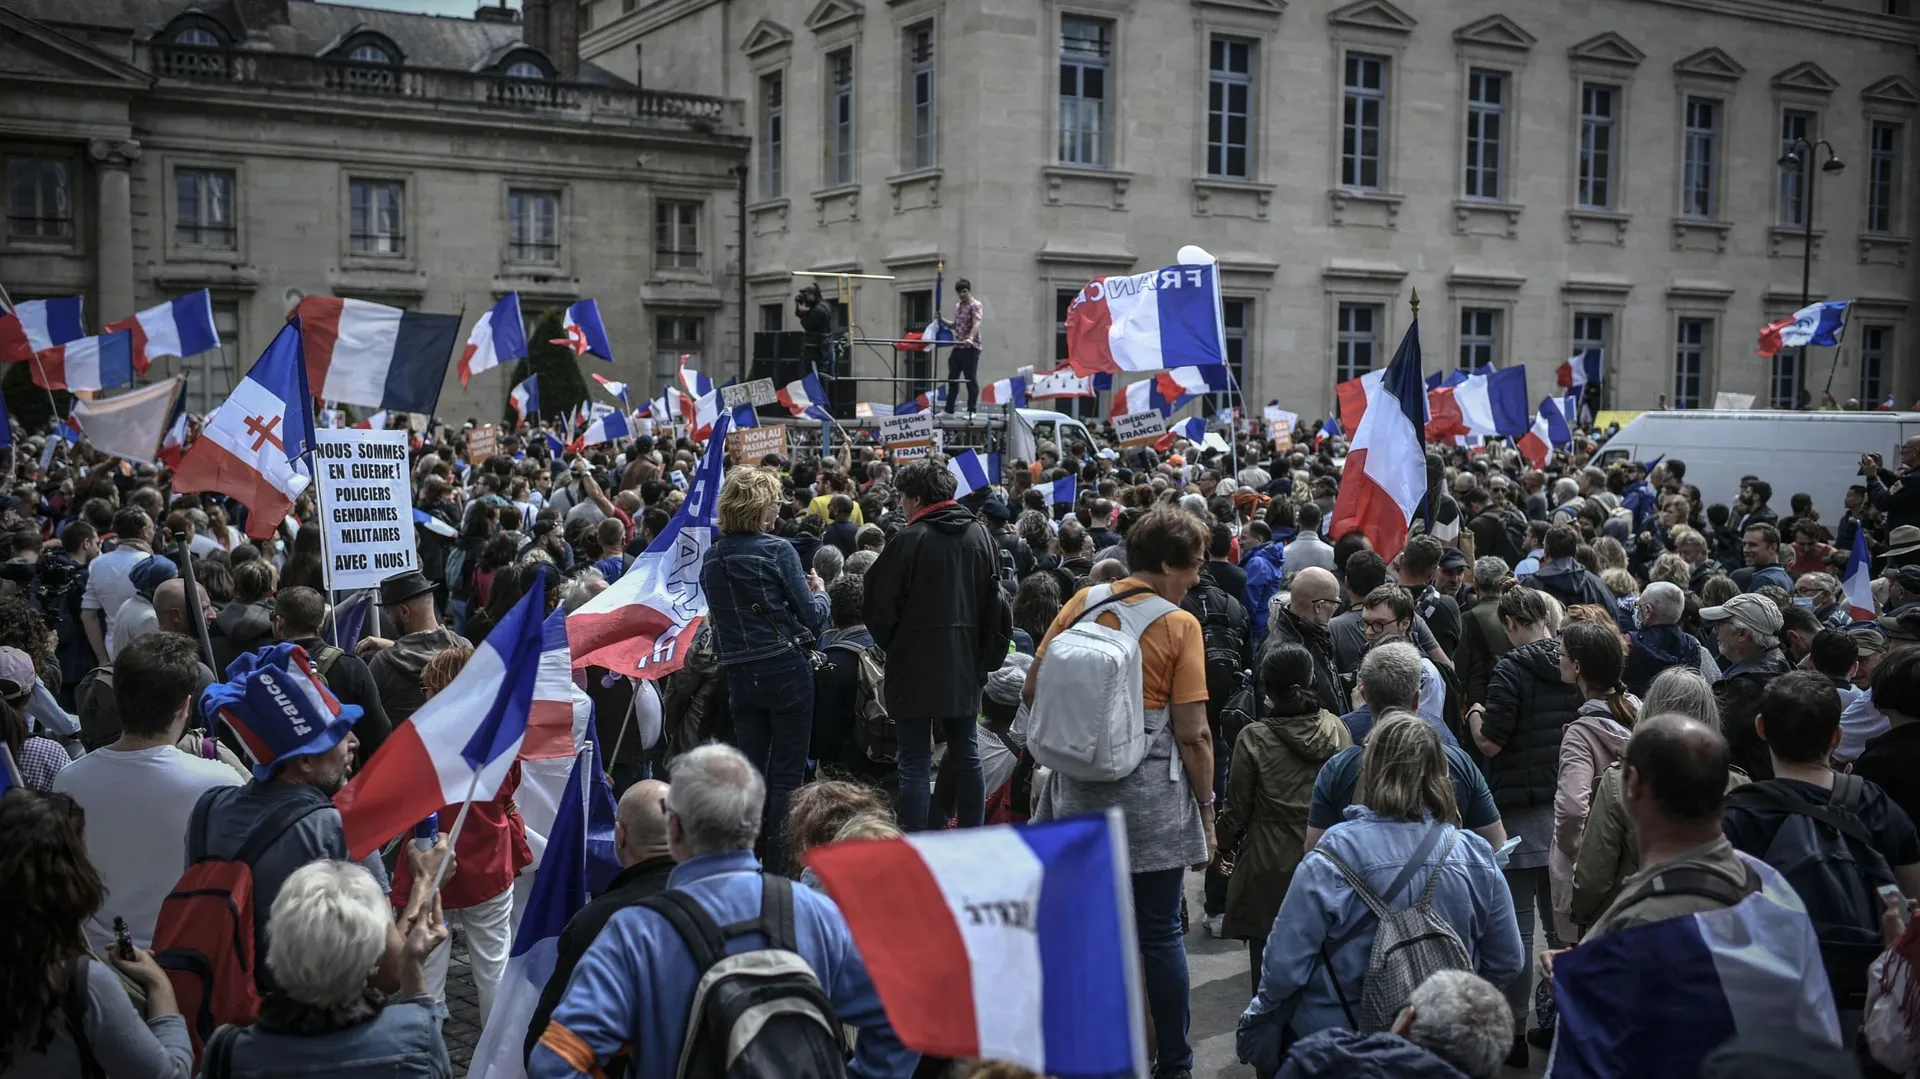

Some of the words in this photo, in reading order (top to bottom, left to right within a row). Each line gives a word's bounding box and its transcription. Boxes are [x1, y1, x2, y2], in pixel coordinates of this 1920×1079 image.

[884, 415, 926, 427] LIBÉRONS
[1118, 411, 1156, 425] LIBÉRONS
[745, 430, 766, 442] NON
[768, 428, 781, 438] AU
[885, 428, 931, 441] FRANCE!
[1120, 424, 1163, 440] FRANCE!
[315, 442, 352, 459] NOUS
[358, 443, 405, 460] SOMMES
[329, 463, 345, 479] EN
[336, 487, 391, 501] POLICIERS
[333, 507, 398, 523] GENDARMES
[341, 527, 400, 543] MILITAIRES
[335, 553, 367, 570] AVEC
[259, 673, 312, 736] France
